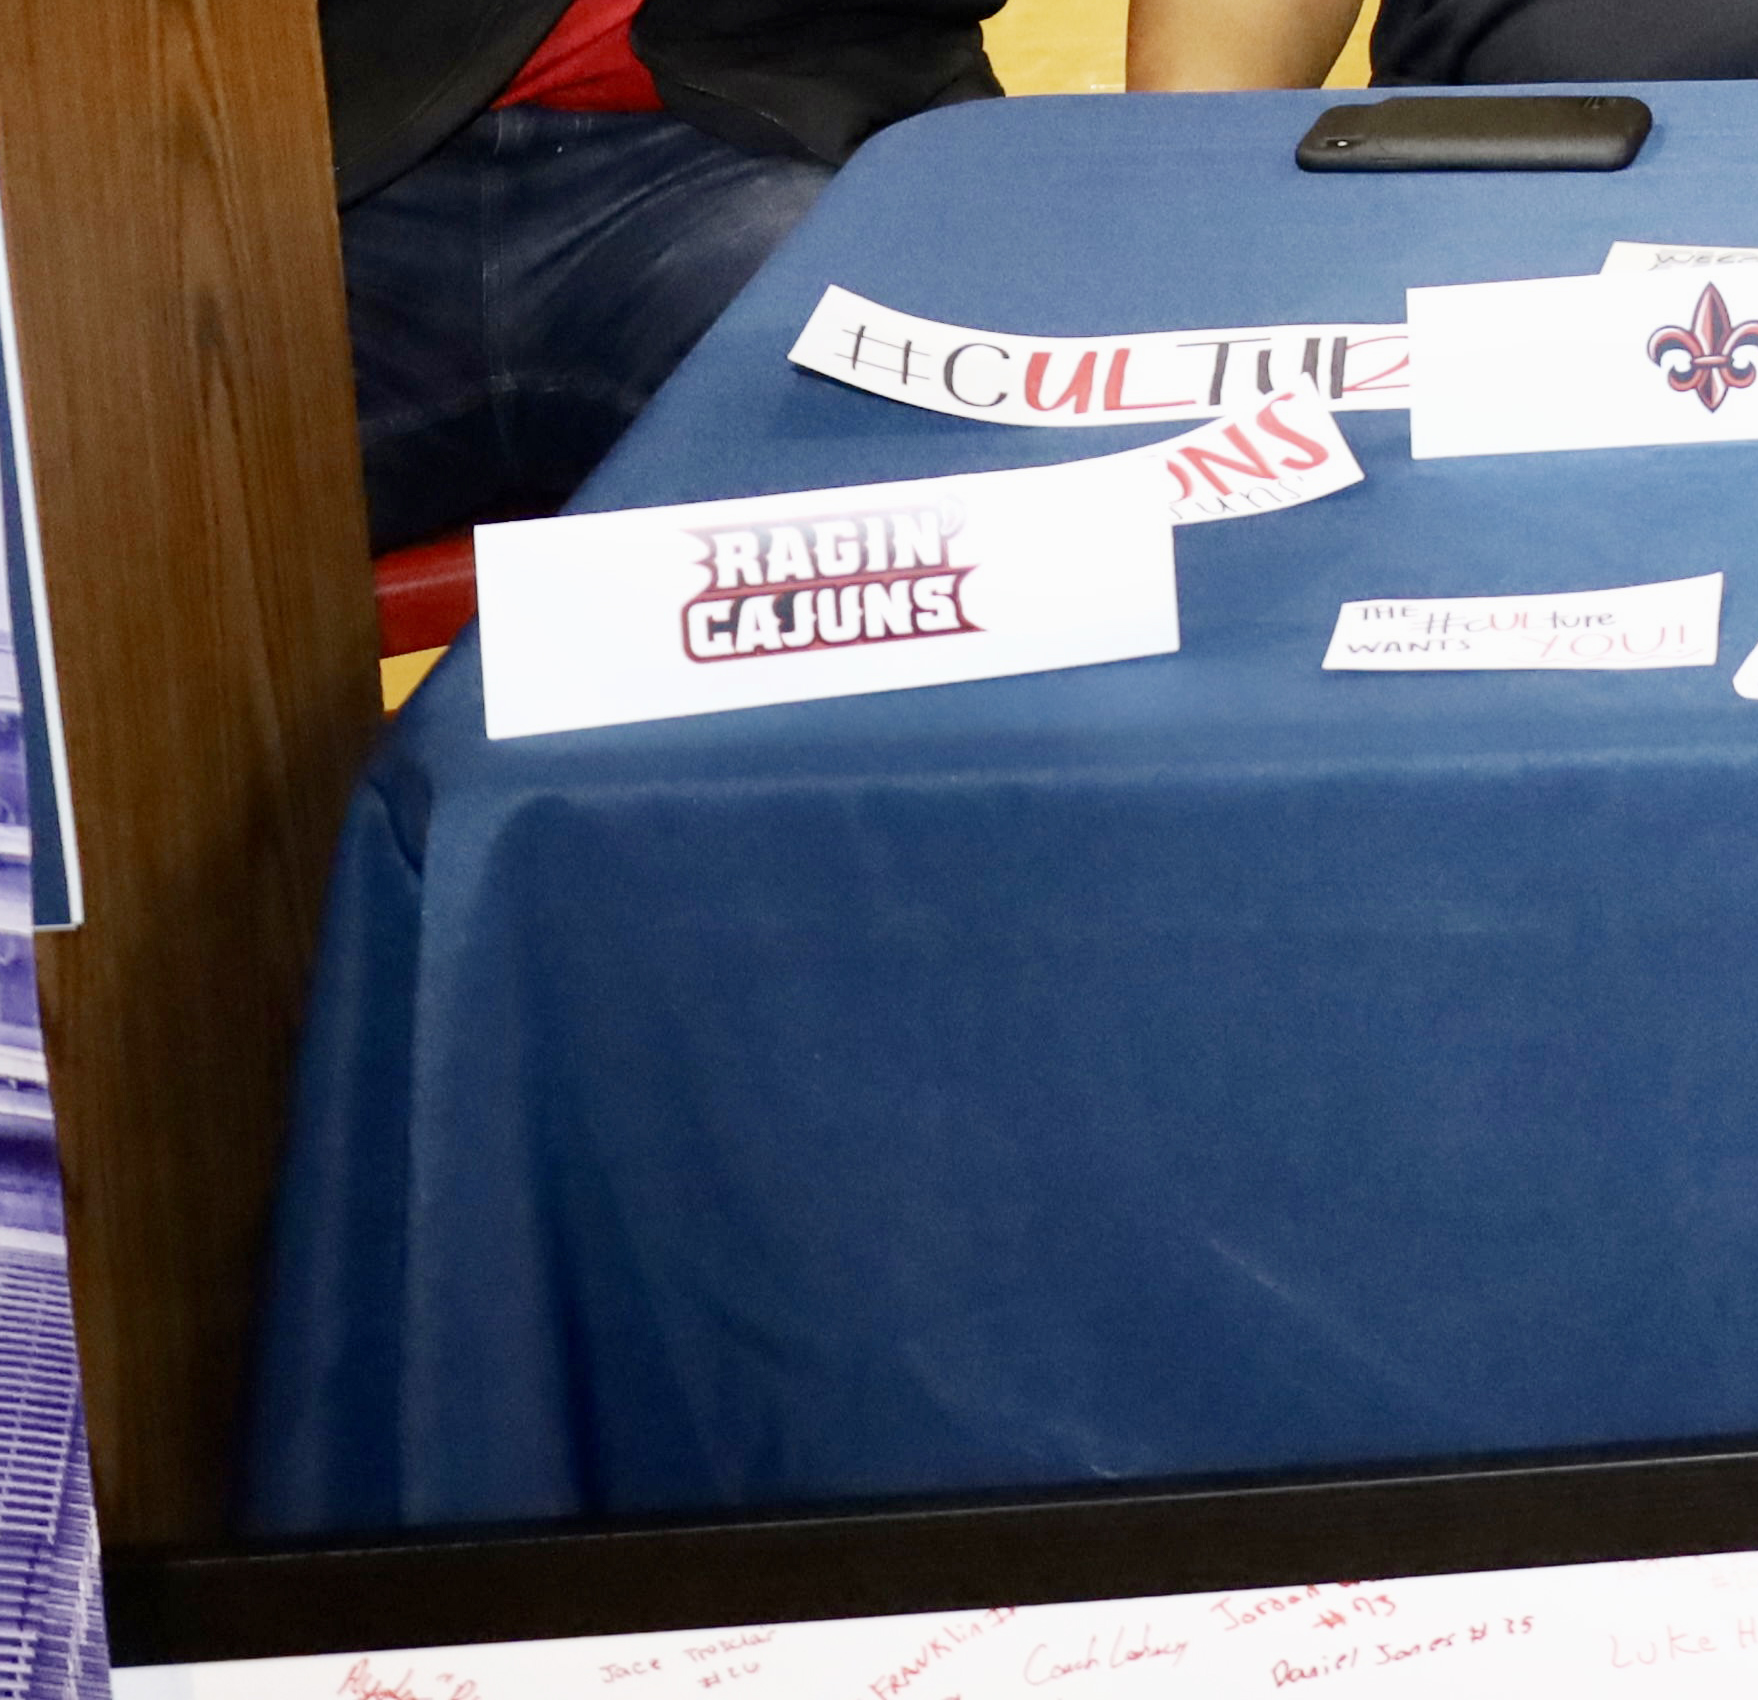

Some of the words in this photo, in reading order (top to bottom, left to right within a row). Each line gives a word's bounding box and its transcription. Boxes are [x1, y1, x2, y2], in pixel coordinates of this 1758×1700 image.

[712, 495, 964, 589] RAGIN'
[687, 574, 961, 658] CAJUNS
[1347, 638, 1471, 656] WANTS
[1521, 625, 1686, 659] YOU!
[1358, 604, 1419, 622] THE
